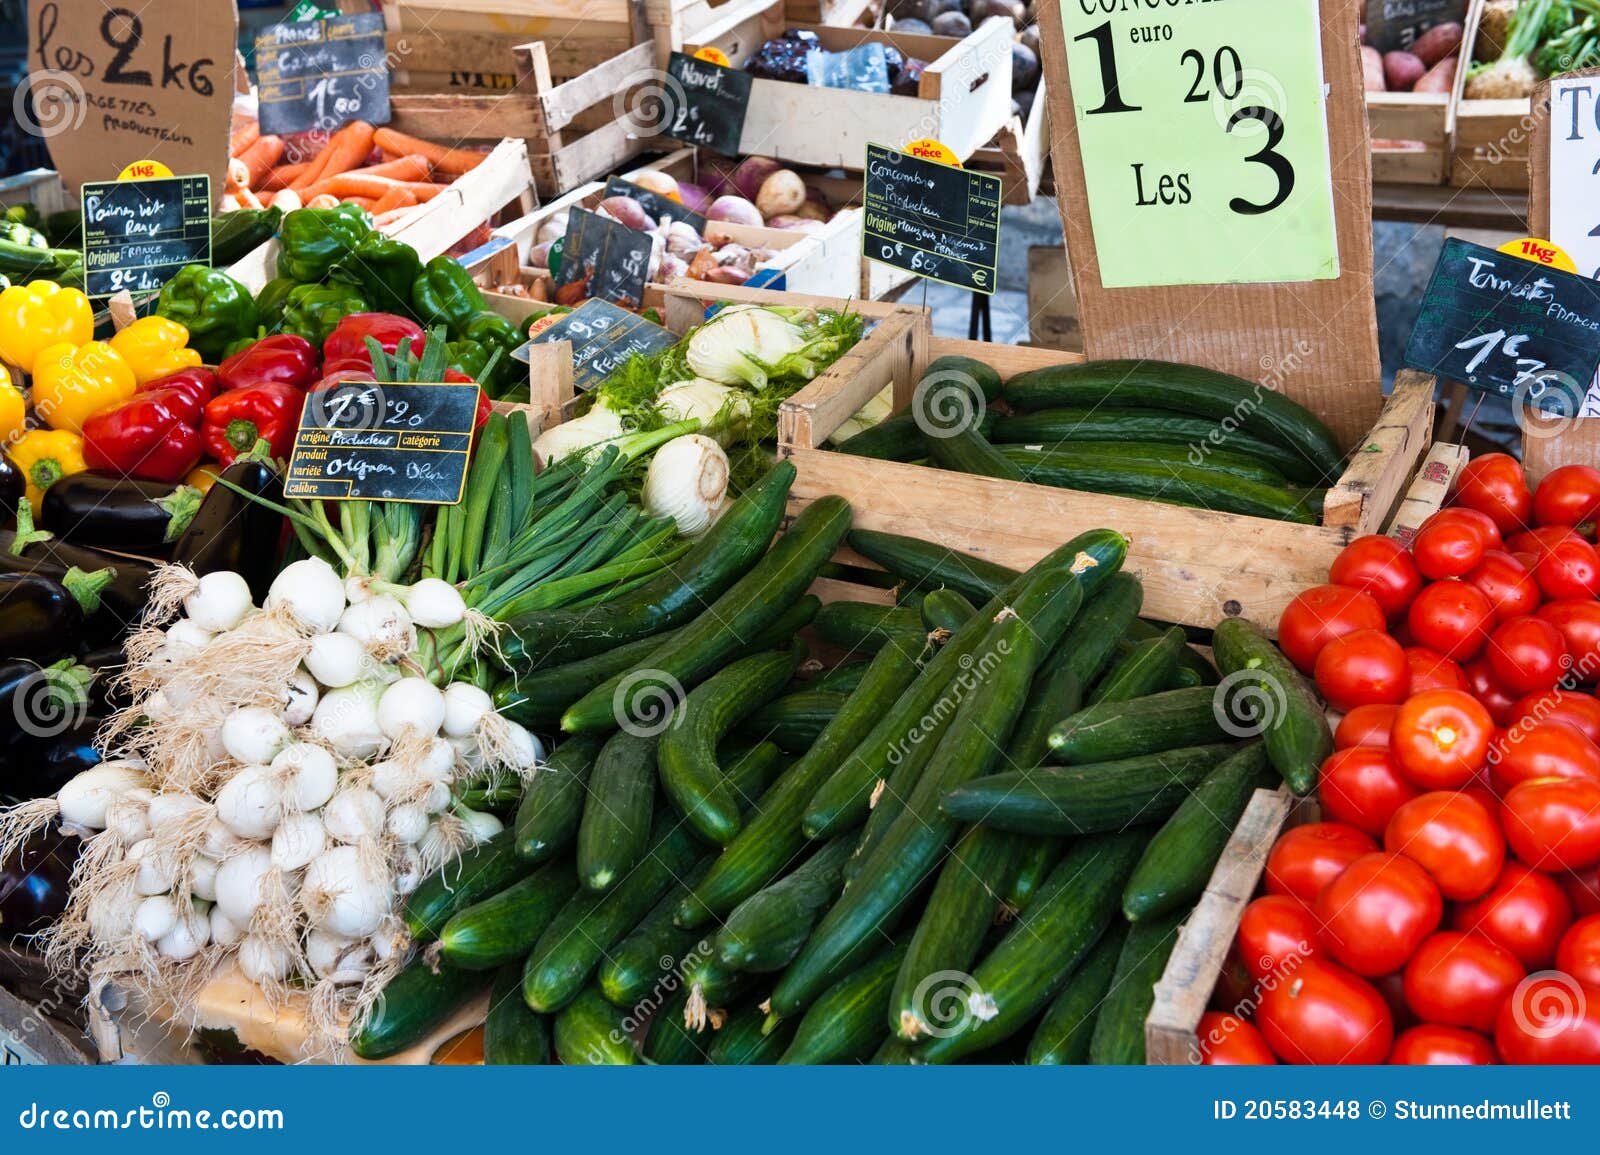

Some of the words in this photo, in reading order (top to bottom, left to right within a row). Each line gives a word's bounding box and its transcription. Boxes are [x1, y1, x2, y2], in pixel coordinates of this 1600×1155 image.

[101, 7, 153, 87] 2
[1074, 20, 1143, 115] 1
[1130, 23, 1173, 44] euro
[1180, 45, 1244, 103] 20
[1559, 86, 1600, 141] T
[912, 147, 942, 159] Pièce
[1130, 162, 1192, 207] Les
[1225, 105, 1295, 216] 3
[129, 165, 154, 177] 1kg
[866, 212, 897, 235] Origine
[88, 250, 120, 266] Origine
[1521, 241, 1557, 264] 1kg
[971, 269, 988, 286] €
[301, 431, 330, 445] origine
[402, 434, 441, 448] catégorie
[296, 449, 327, 461] produit
[293, 465, 322, 476] variété
[289, 481, 318, 494] calibre
